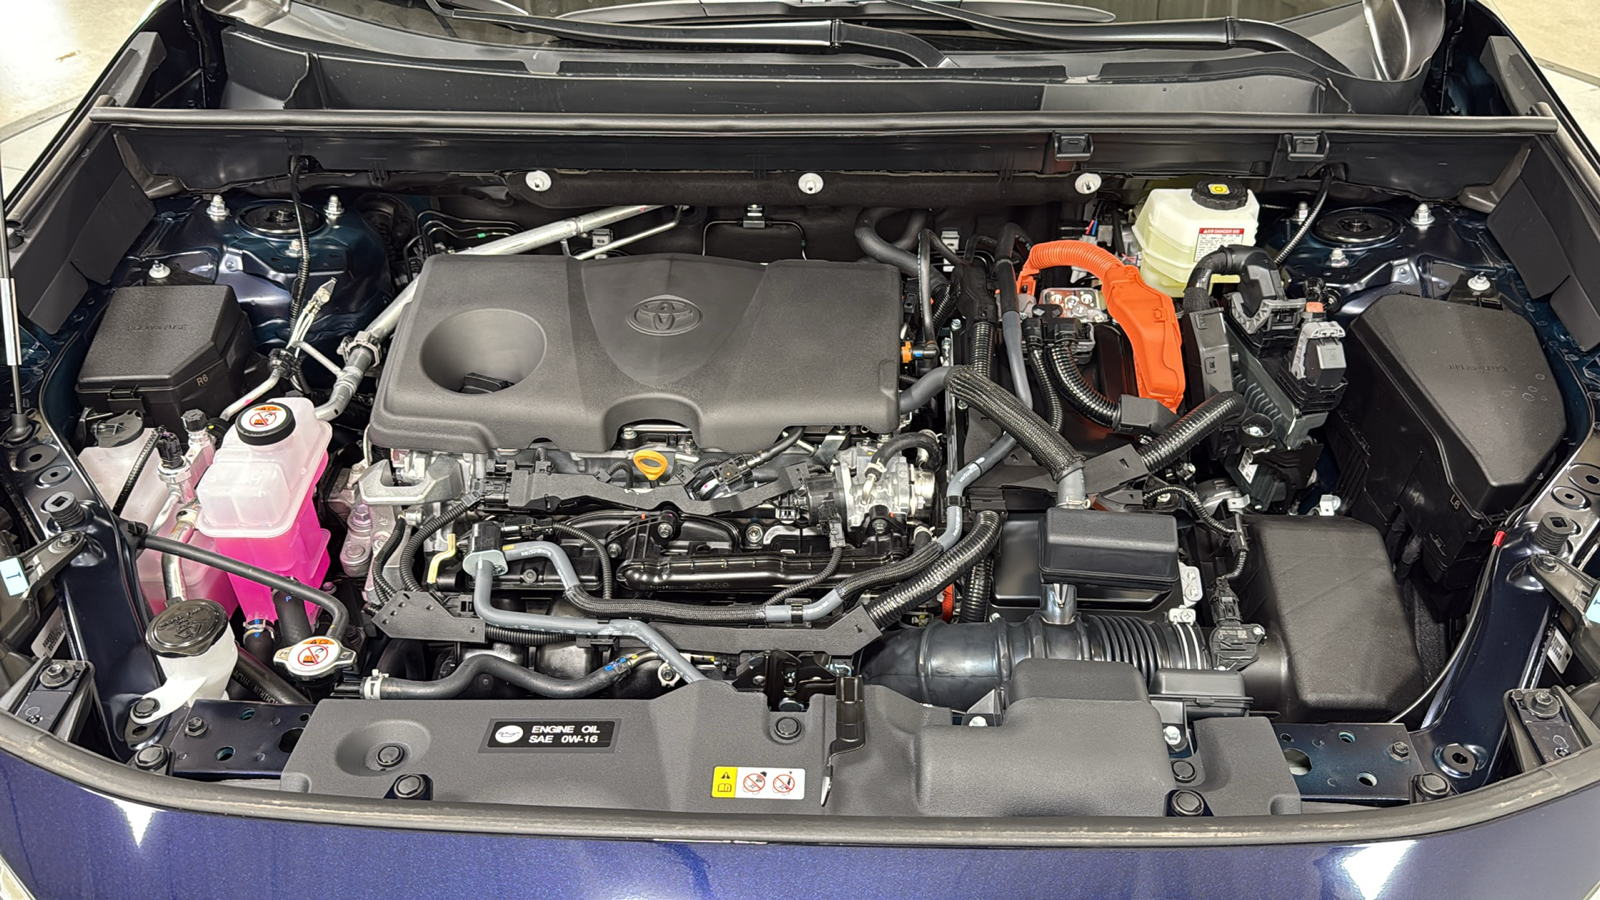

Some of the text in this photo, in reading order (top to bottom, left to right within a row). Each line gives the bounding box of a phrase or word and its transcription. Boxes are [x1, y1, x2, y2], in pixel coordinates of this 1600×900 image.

[196, 374, 209, 386] R6
[531, 725, 601, 733] ENGINE OIL
[528, 735, 598, 743] SAE 0W-16
